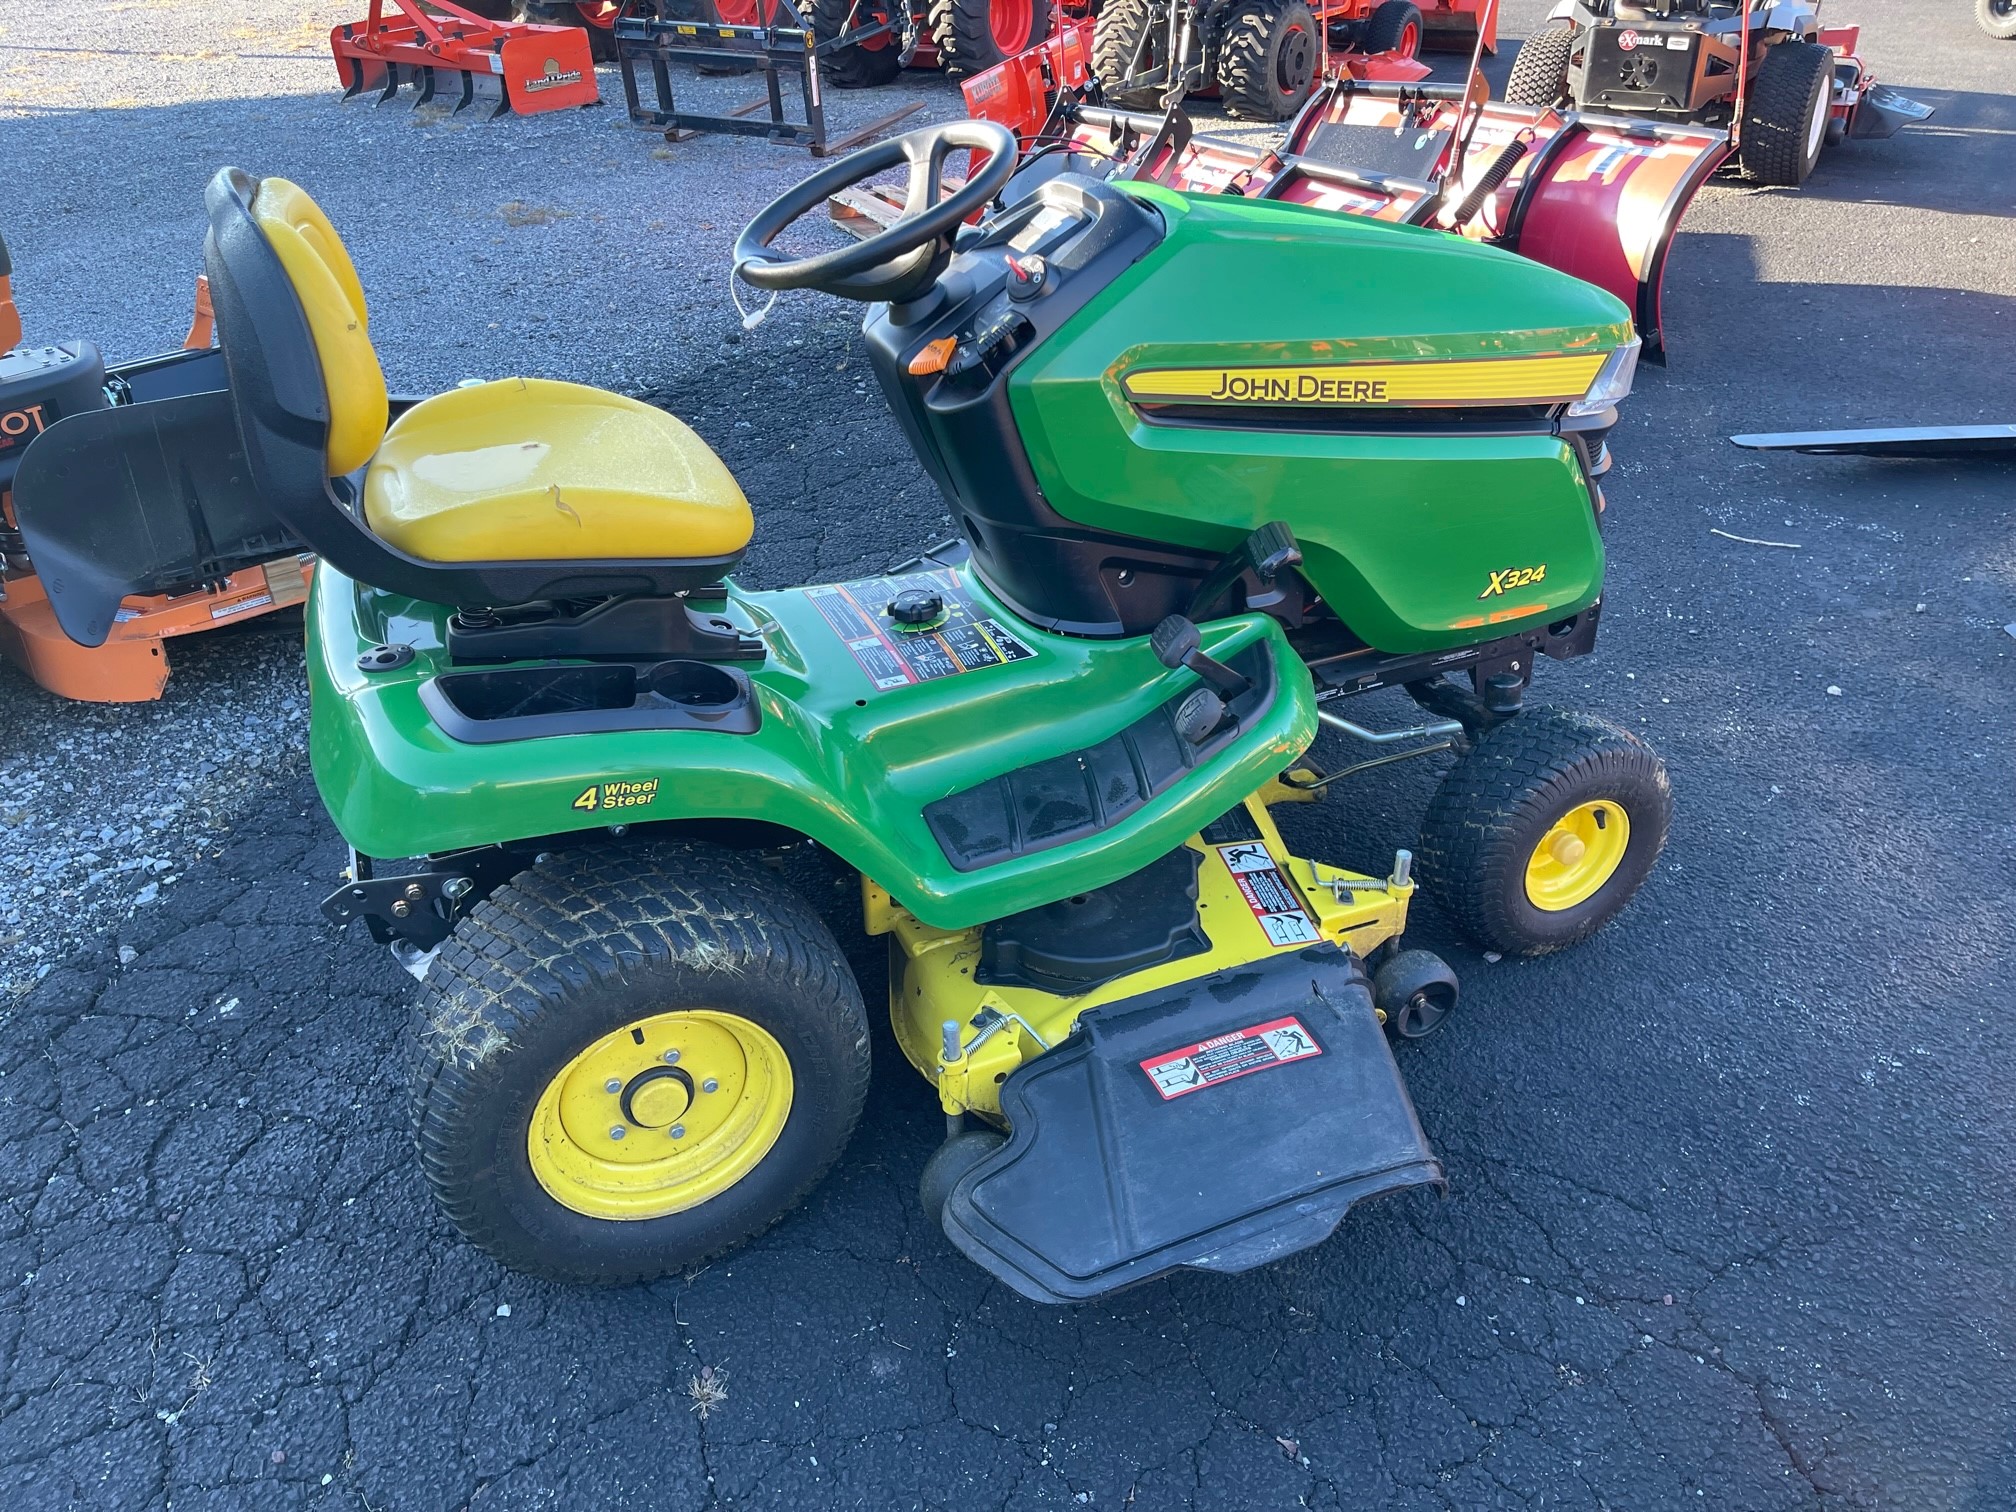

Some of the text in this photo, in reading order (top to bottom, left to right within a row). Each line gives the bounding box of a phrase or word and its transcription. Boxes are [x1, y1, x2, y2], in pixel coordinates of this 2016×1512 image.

[1212, 373, 1387, 400] JOHN DEERE
[1479, 563, 1547, 599] X324
[574, 778, 659, 810] 4 Wheel
[602, 793, 656, 809] Steer
[1237, 878, 1258, 903] DANGER
[1206, 1032, 1246, 1049] DANGER
